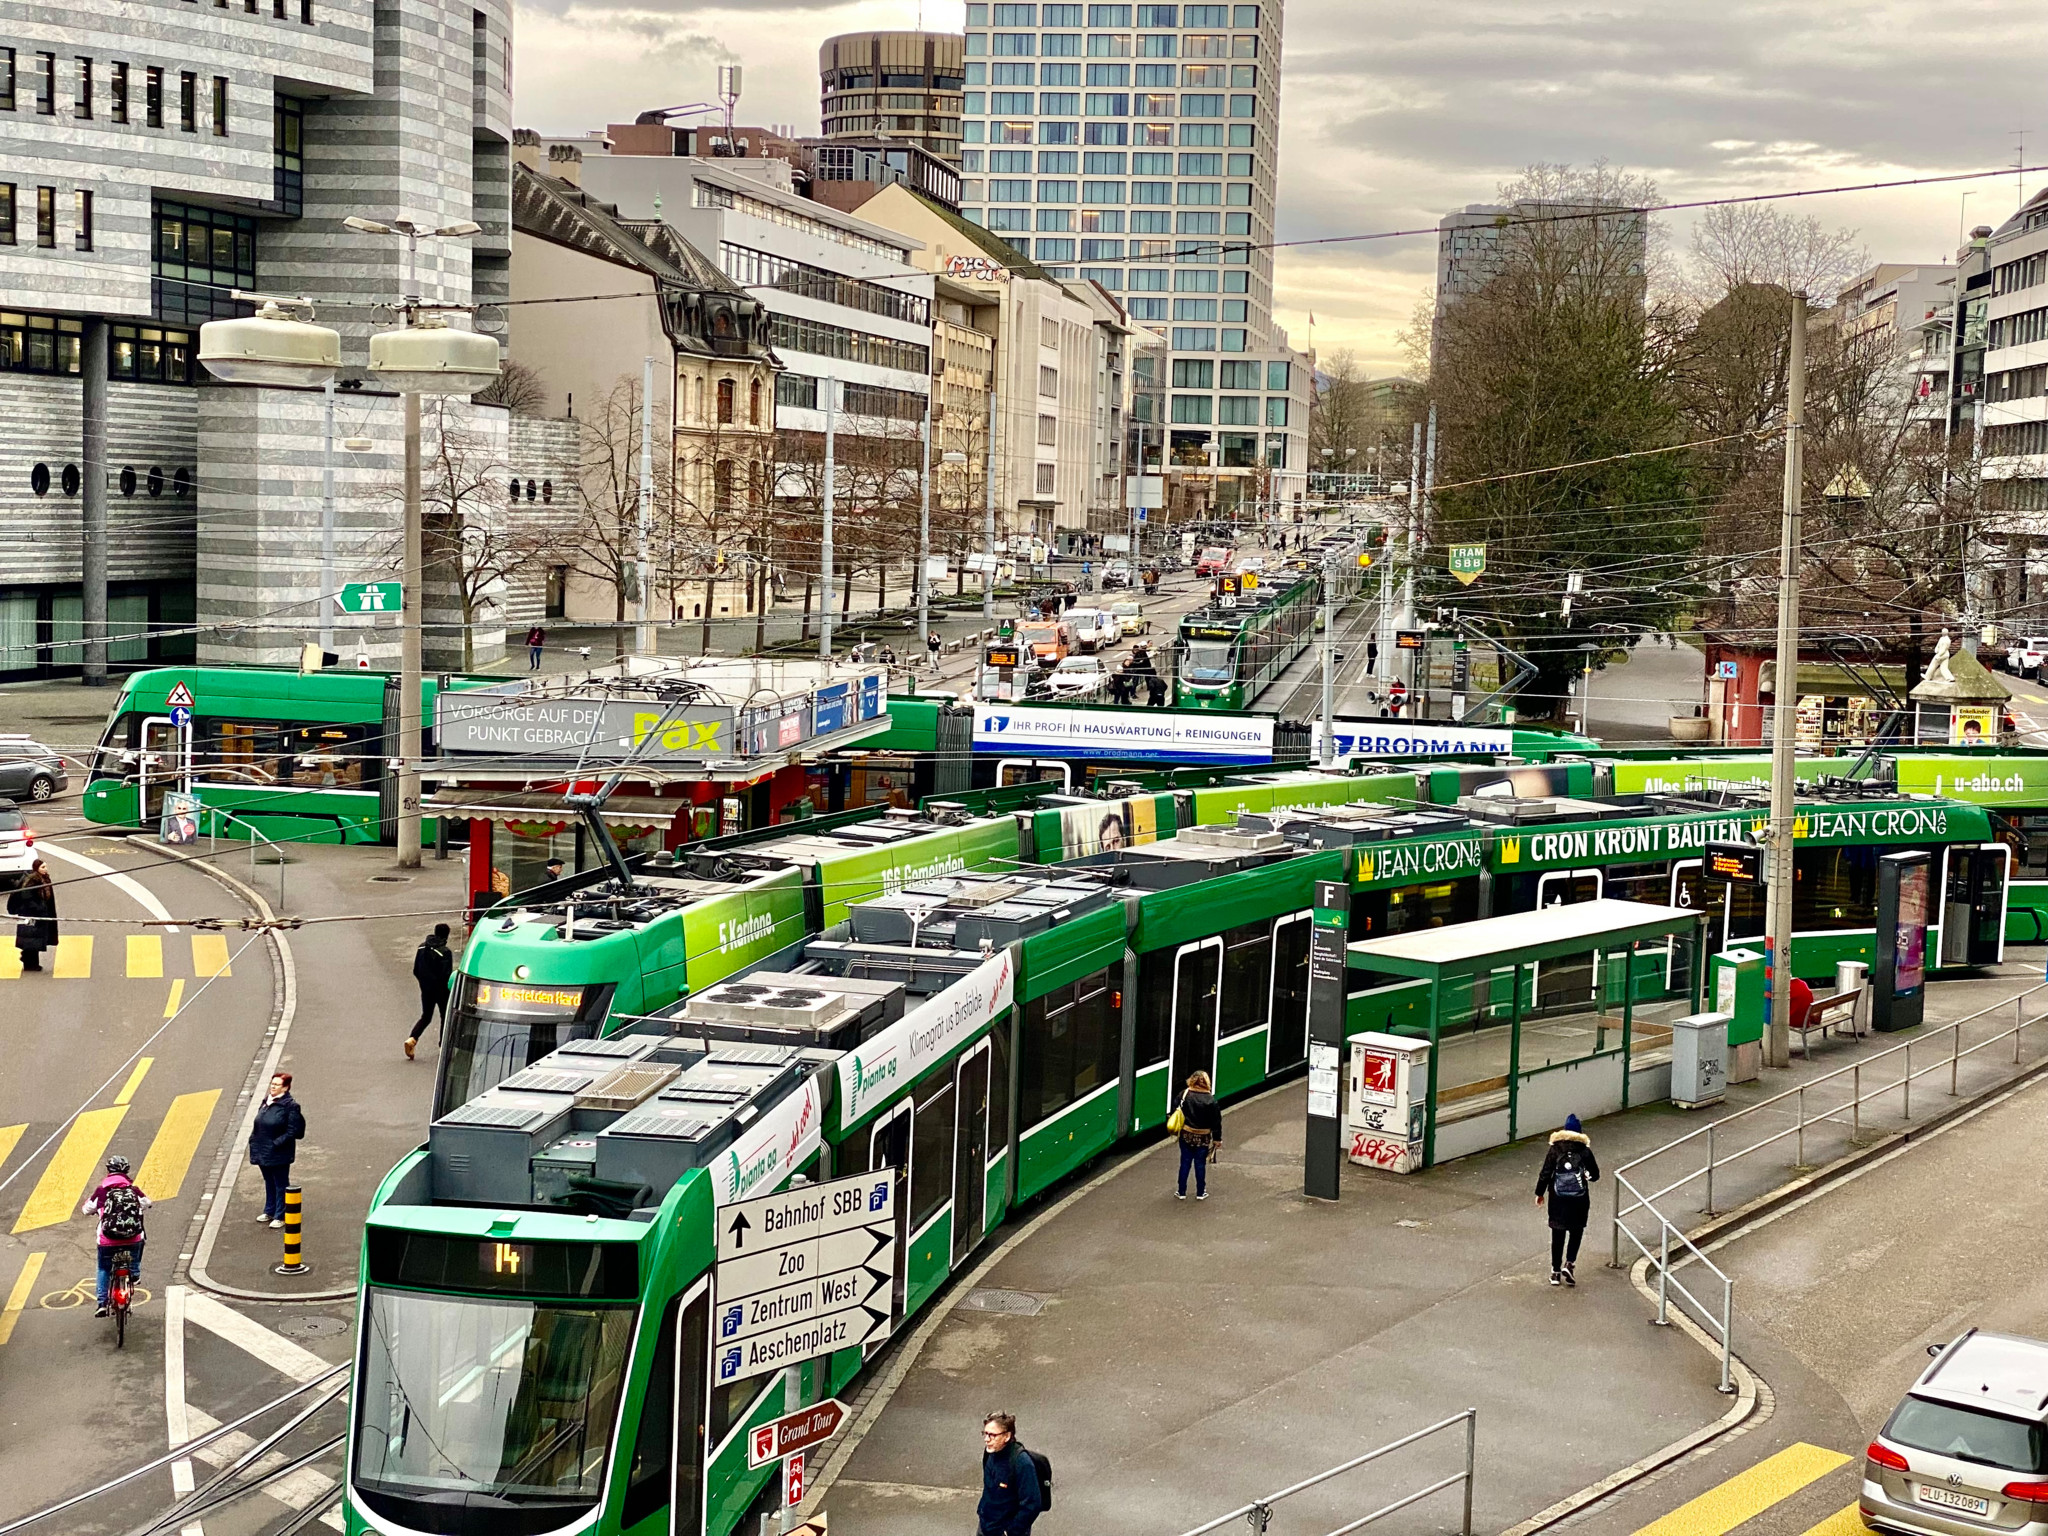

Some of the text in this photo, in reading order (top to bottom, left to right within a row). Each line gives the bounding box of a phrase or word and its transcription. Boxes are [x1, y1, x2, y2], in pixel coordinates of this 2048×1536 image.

[1452, 548, 1484, 557] TRAM
[1455, 559, 1481, 568] SBB
[1003, 620, 1010, 628] A
[451, 704, 605, 725] VORSORGE AUF DEN
[468, 725, 605, 745] PUNKT GEBRACHT
[633, 712, 722, 751] Pax
[1013, 720, 1031, 730] IHR
[1034, 722, 1066, 732] PROFI
[1069, 723, 1081, 733] IN
[1084, 724, 1171, 737] HAUSWARTUNG
[1185, 729, 1262, 741] REINIGUNGEN
[1358, 735, 1505, 755] BRODMANN
[1645, 777, 1680, 792] Alles
[1954, 773, 2024, 792] u-abo.ch
[1809, 812, 1866, 838] JEAN
[1871, 809, 1938, 837] CRON
[1530, 818, 1742, 861] CRON KRÖNT BAUTEN
[1374, 845, 1419, 880] JEAN
[1422, 841, 1474, 873] CRON
[881, 866, 901, 896] 166
[1323, 885, 1335, 907] F
[719, 922, 727, 954] 5
[556, 991, 582, 1008] Hard
[862, 1057, 897, 1099] pianta ag
[740, 1148, 777, 1195] pianta ag
[764, 1196, 825, 1233] Bahnhof
[833, 1188, 862, 1216] SBB
[496, 1243, 520, 1274] 14
[778, 1251, 805, 1277] Zoo
[750, 1288, 813, 1325] Zentrum
[821, 1275, 858, 1305] West
[749, 1321, 847, 1367] Aeschenplatz
[780, 1412, 835, 1445] Grand Tour
